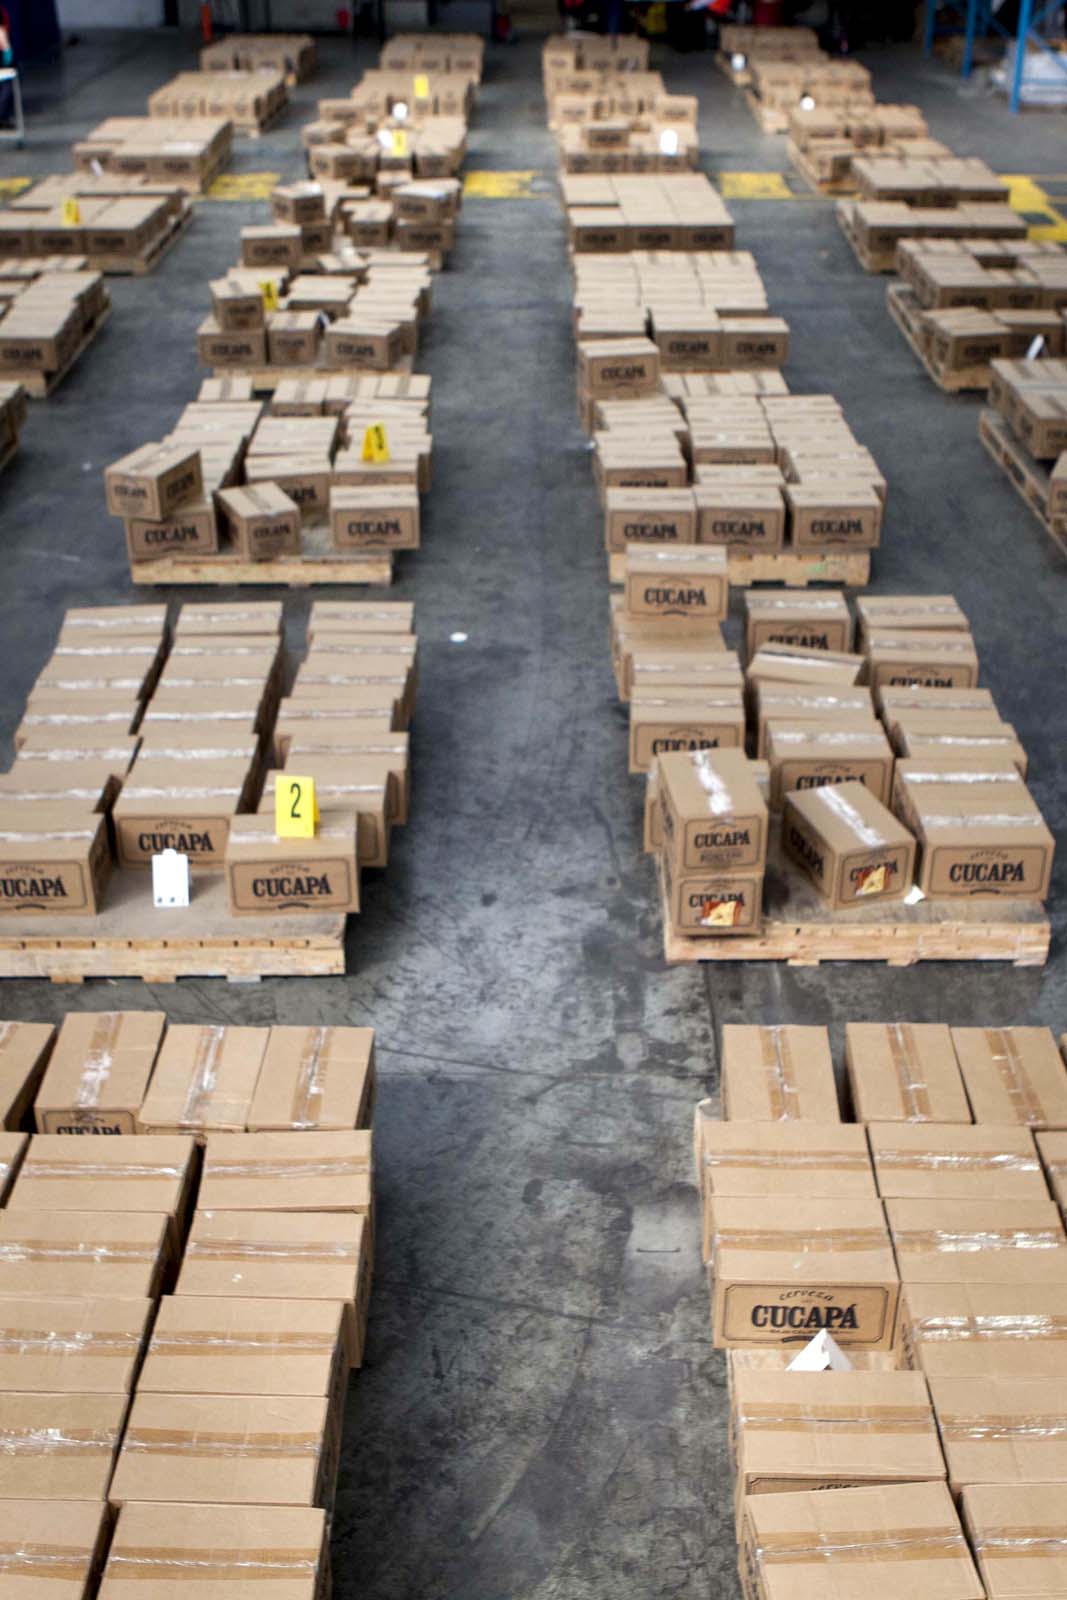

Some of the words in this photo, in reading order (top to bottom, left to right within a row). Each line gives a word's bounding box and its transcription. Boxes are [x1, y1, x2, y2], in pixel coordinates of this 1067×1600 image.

[290, 783, 302, 819] 2
[949, 859, 1025, 882] CUCAPÁ
[0, 874, 69, 897] UCAPÁ
[252, 872, 332, 897] CUCAPÁ
[779, 1289, 834, 1301] cerveza
[751, 1303, 859, 1329] CUCAPÁ
